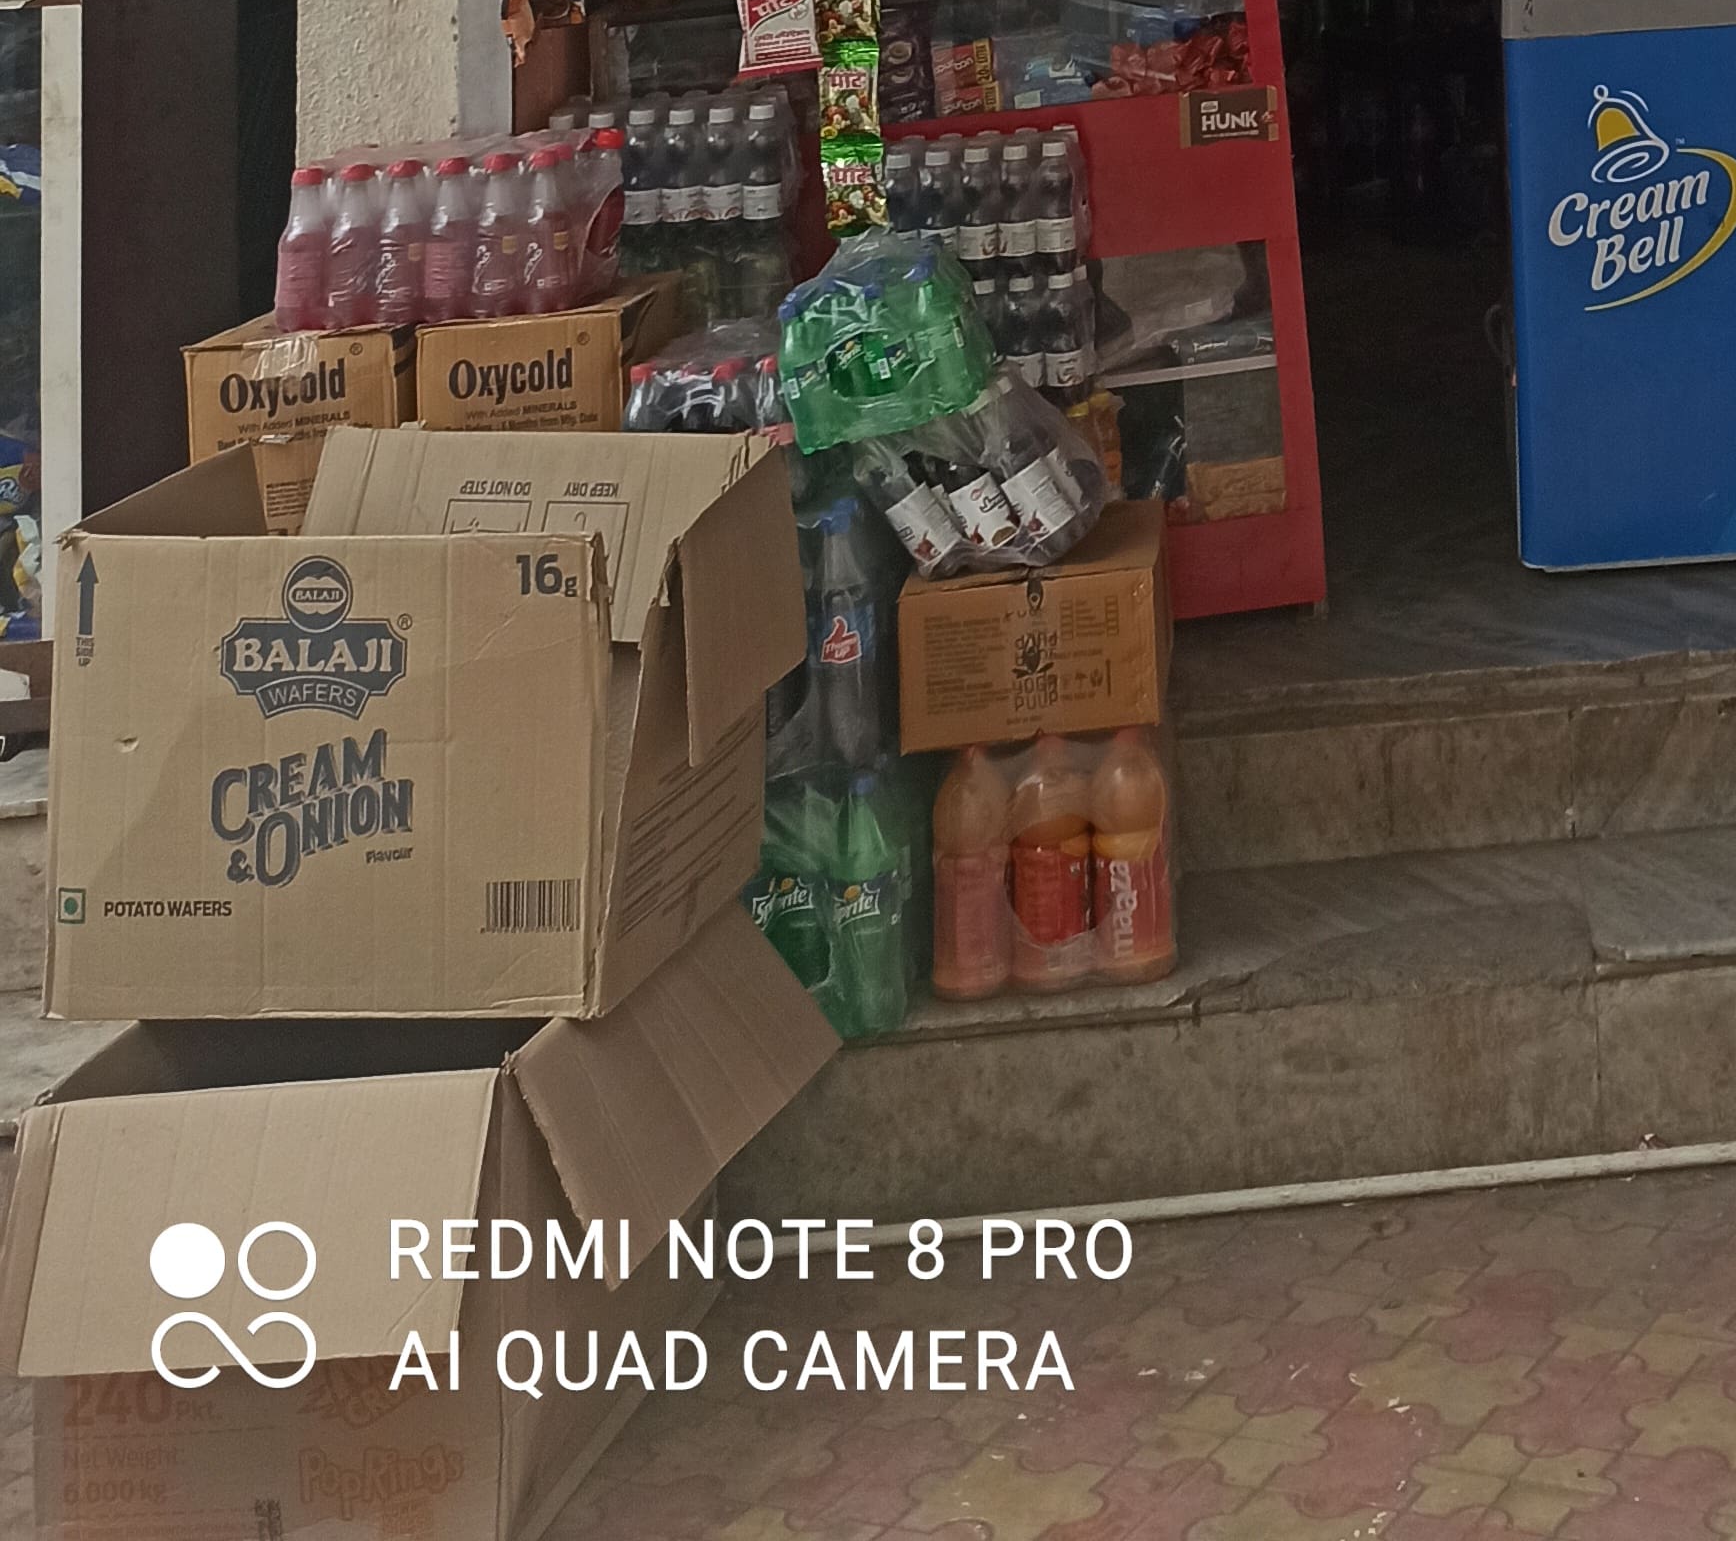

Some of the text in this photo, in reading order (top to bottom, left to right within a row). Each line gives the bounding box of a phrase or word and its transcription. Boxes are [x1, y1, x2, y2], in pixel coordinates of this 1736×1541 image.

[1201, 109, 1260, 133] HUNK
[1548, 169, 1710, 248] Cream
[1590, 215, 1685, 293] Bell
[220, 358, 347, 420] Oxycold
[450, 347, 573, 406] Oxycold
[460, 481, 532, 496] DO NOT STEP
[563, 482, 618, 498] KEEP DRY
[295, 588, 342, 603] BALAJI
[233, 638, 395, 675] BALAJI
[267, 682, 359, 711] WAFERS
[211, 728, 388, 842] CREAM
[227, 779, 415, 889] & ONION
[104, 900, 233, 918] POTATO WAFERS
[108, 1445, 184, 1470] Weight
[140, 1479, 172, 1506] kg
[298, 1441, 467, 1520] PopRings
